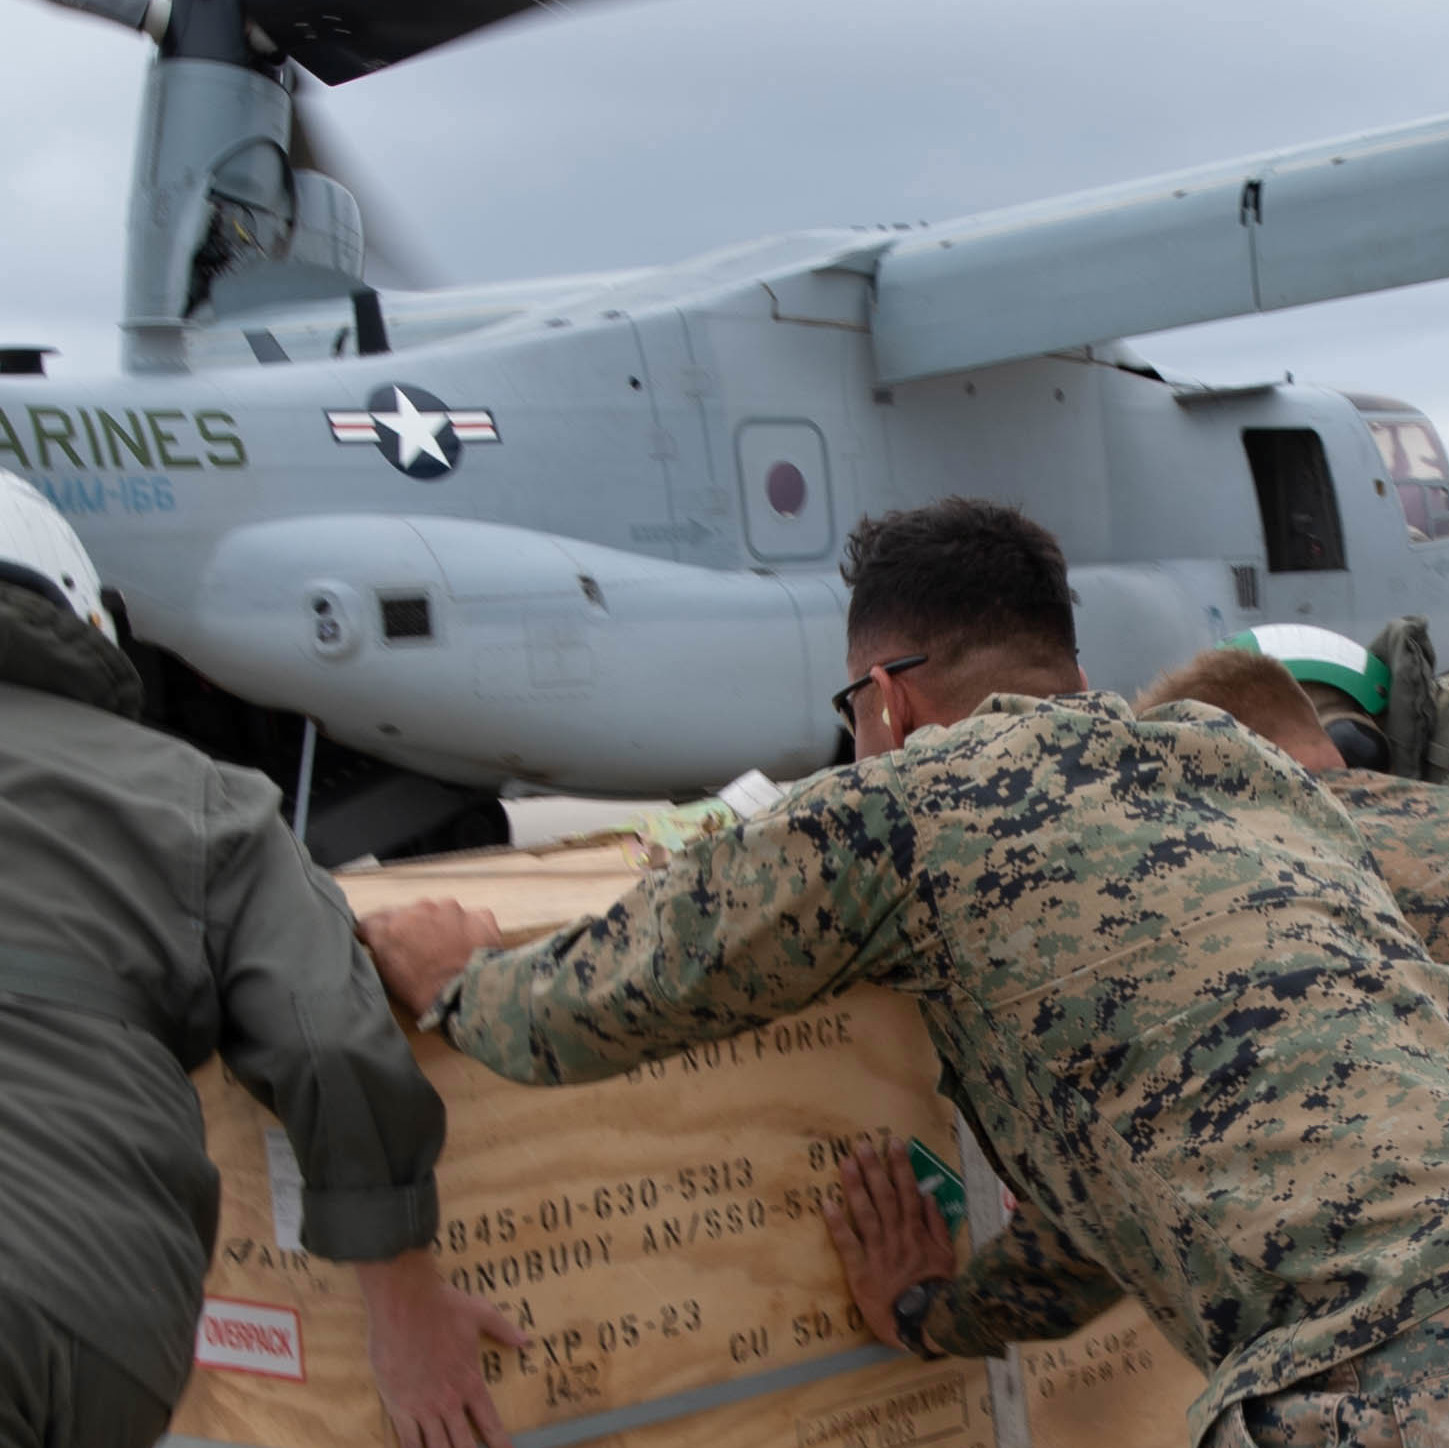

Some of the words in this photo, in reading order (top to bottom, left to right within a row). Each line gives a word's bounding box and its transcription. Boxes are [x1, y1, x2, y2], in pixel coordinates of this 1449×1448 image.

[30, 475, 177, 513] MM-166
[754, 1012, 852, 1060] FORCE
[451, 1231, 613, 1296] ONOBUOY
[205, 1314, 294, 1360] OVERPACK
[598, 1299, 702, 1353] 05-23
